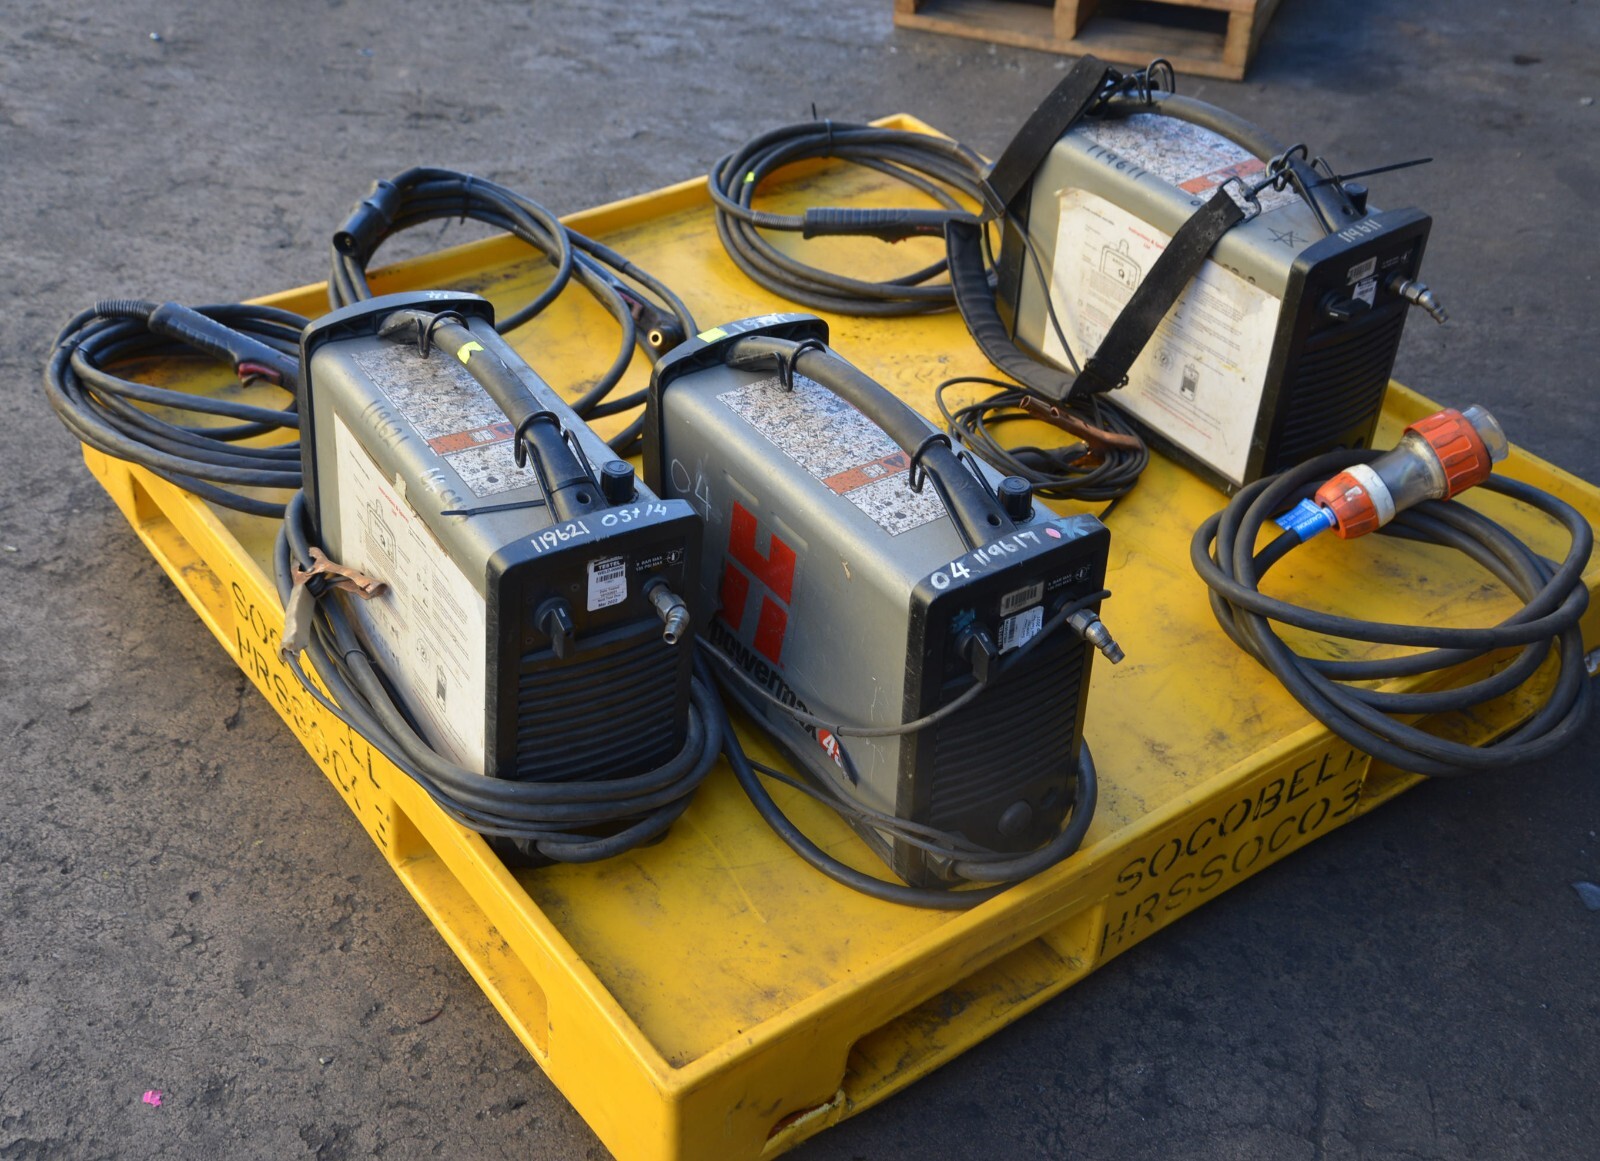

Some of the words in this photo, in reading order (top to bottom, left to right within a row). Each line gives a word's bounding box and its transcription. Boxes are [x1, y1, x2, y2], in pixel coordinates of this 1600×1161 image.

[1087, 142, 1146, 178] 119611
[360, 399, 410, 450] 119621
[530, 520, 590, 553] 119621
[930, 561, 971, 590] 04
[973, 530, 1041, 567] 119617
[1100, 777, 1363, 957] HRSSOCO3
